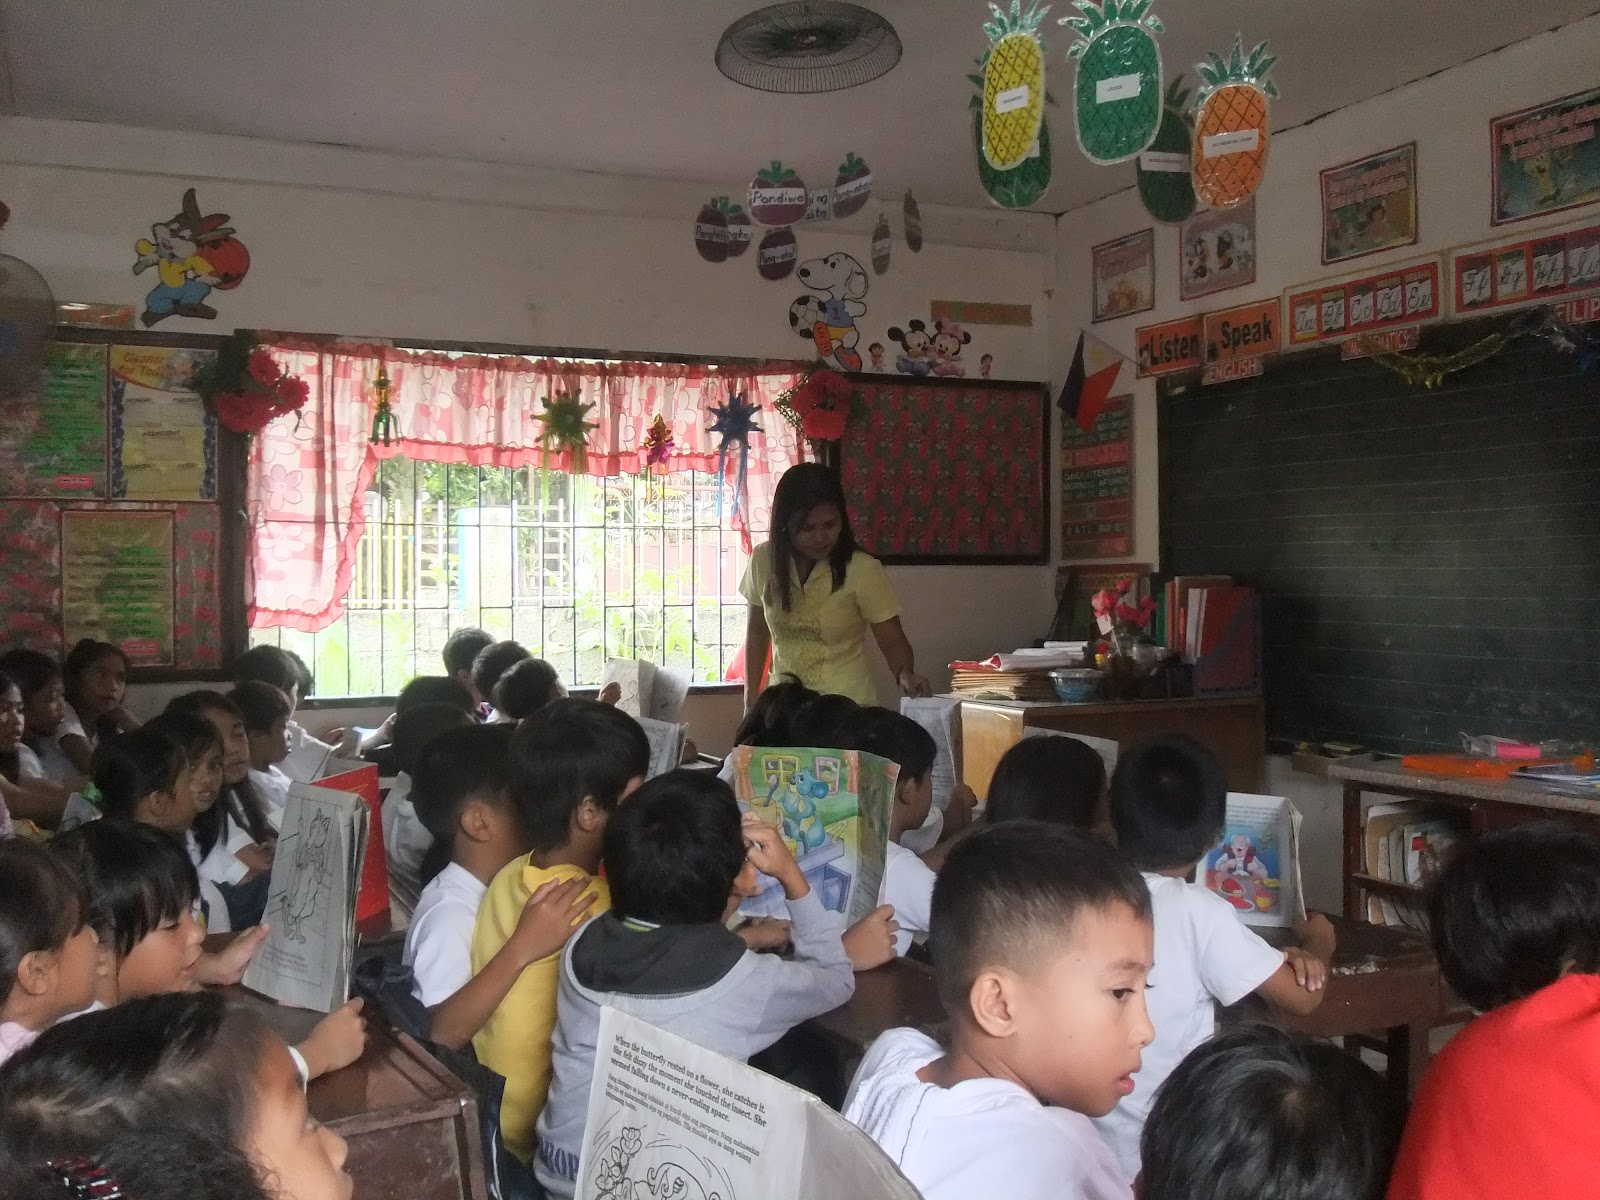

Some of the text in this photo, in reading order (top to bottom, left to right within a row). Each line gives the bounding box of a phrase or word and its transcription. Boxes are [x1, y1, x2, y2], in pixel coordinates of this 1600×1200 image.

[753, 190, 805, 204] Pandiwa
[1149, 332, 1199, 366] Listen
[1221, 311, 1272, 355] Speak
[1209, 357, 1257, 380] ENGLISH
[611, 1056, 632, 1073] seemed
[631, 1065, 650, 1084] falling
[650, 1074, 666, 1090] down
[671, 1087, 711, 1115] never-ending
[711, 1107, 731, 1123] space.
[613, 1044, 623, 1057] She
[623, 1049, 633, 1062] felt
[633, 1054, 648, 1070] dizzy
[648, 1062, 659, 1074] the
[658, 1068, 684, 1087] moment
[684, 1079, 695, 1092] she
[696, 1085, 721, 1104] touched
[720, 1097, 732, 1110] the
[754, 1113, 767, 1128] She
[616, 1034, 631, 1049] When
[631, 1042, 641, 1054] the
[641, 1045, 668, 1067] butterfly
[667, 1060, 686, 1075] rested
[686, 1069, 695, 1079] on
[695, 1074, 700, 1082] a
[699, 1074, 721, 1094] flower,
[722, 1086, 734, 1098] she
[734, 1093, 759, 1110] catches
